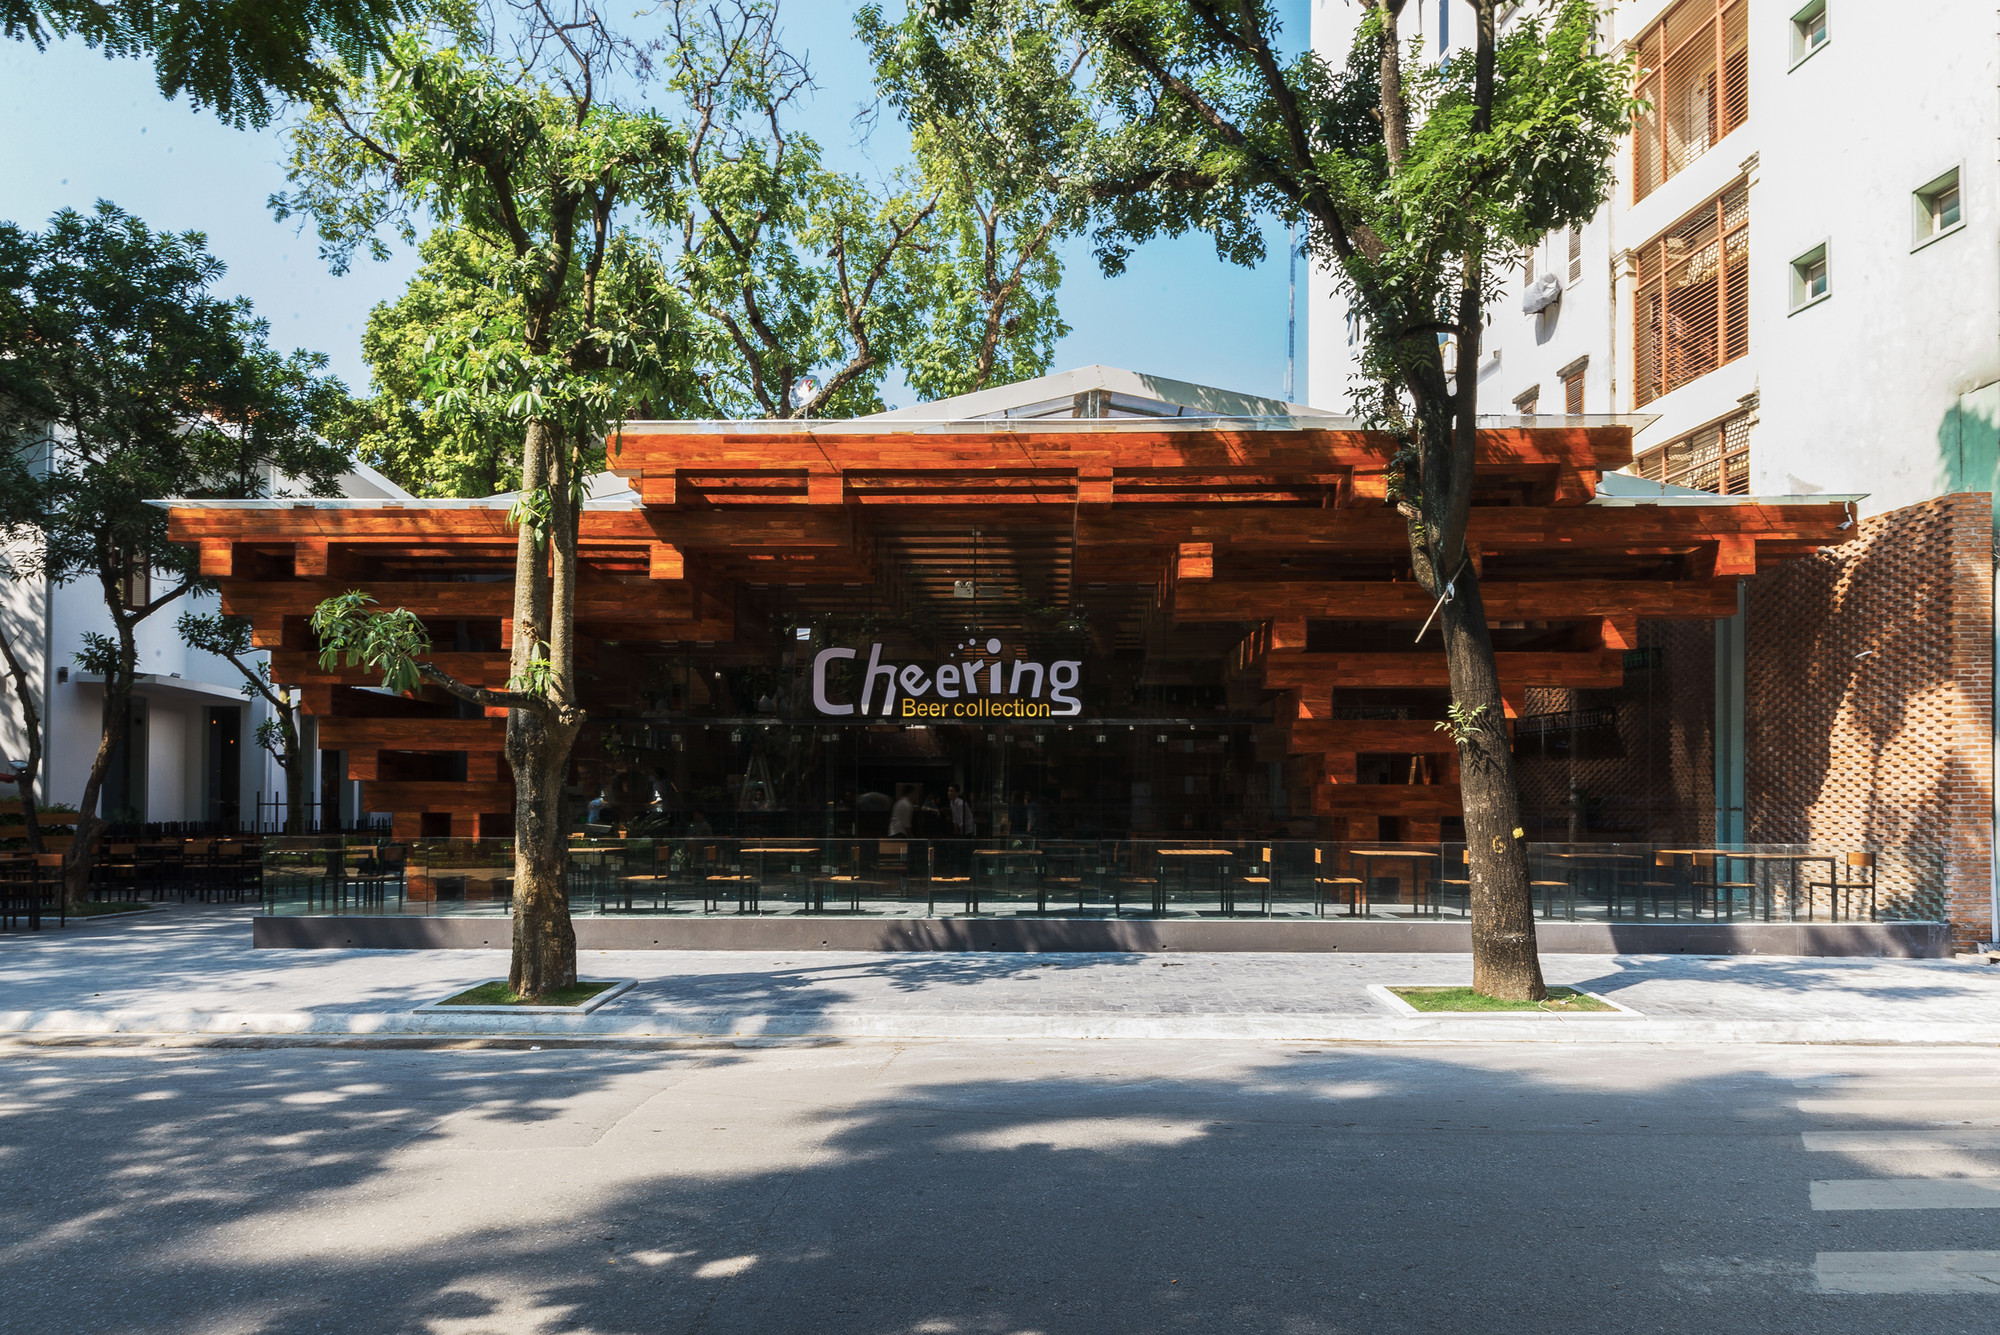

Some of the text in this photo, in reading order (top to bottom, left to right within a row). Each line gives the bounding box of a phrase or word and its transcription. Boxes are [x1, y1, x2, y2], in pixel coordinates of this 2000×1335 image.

[813, 638, 1082, 716] Cheering
[902, 698, 1050, 717] Beer collection
